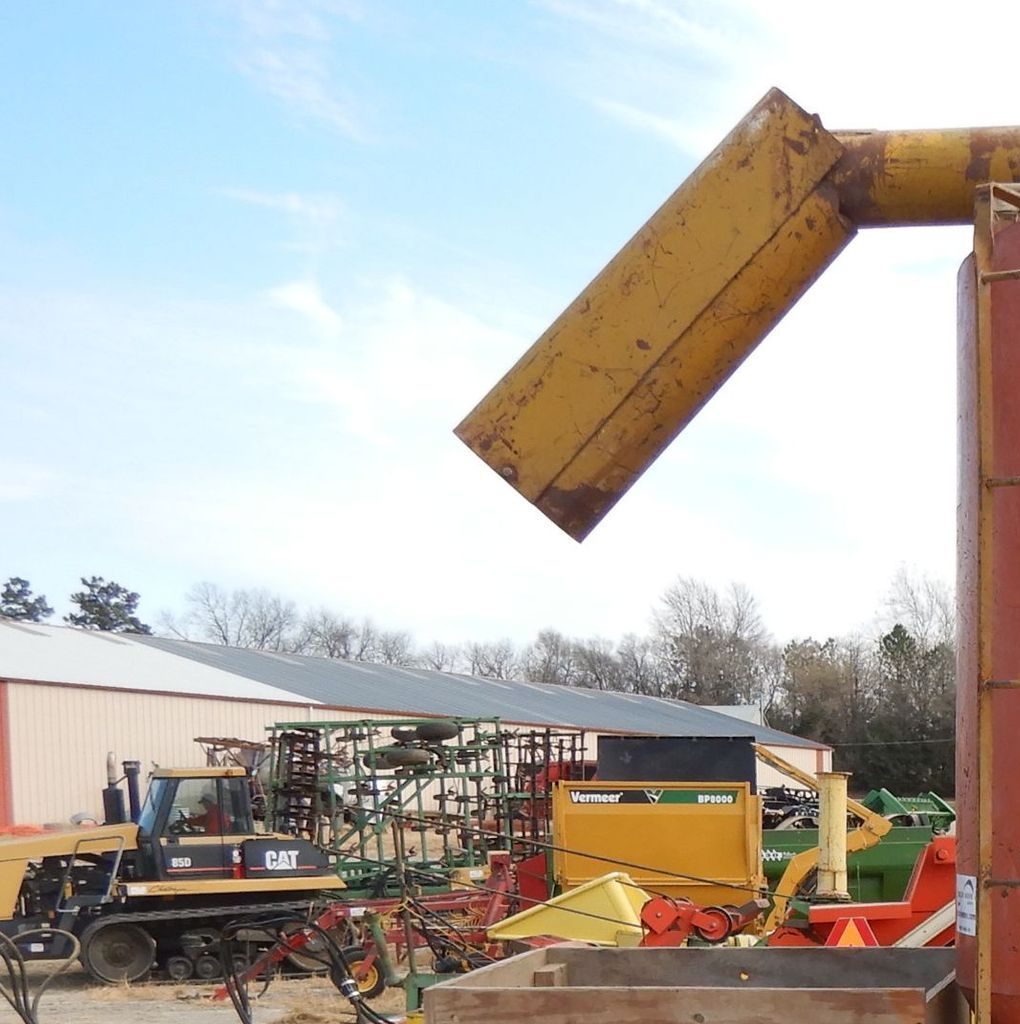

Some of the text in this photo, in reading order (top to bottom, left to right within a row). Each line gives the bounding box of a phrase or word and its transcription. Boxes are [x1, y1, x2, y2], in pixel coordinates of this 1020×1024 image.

[570, 791, 621, 804] Vermeer
[171, 857, 192, 868] 85D
[265, 850, 299, 870] CAT
